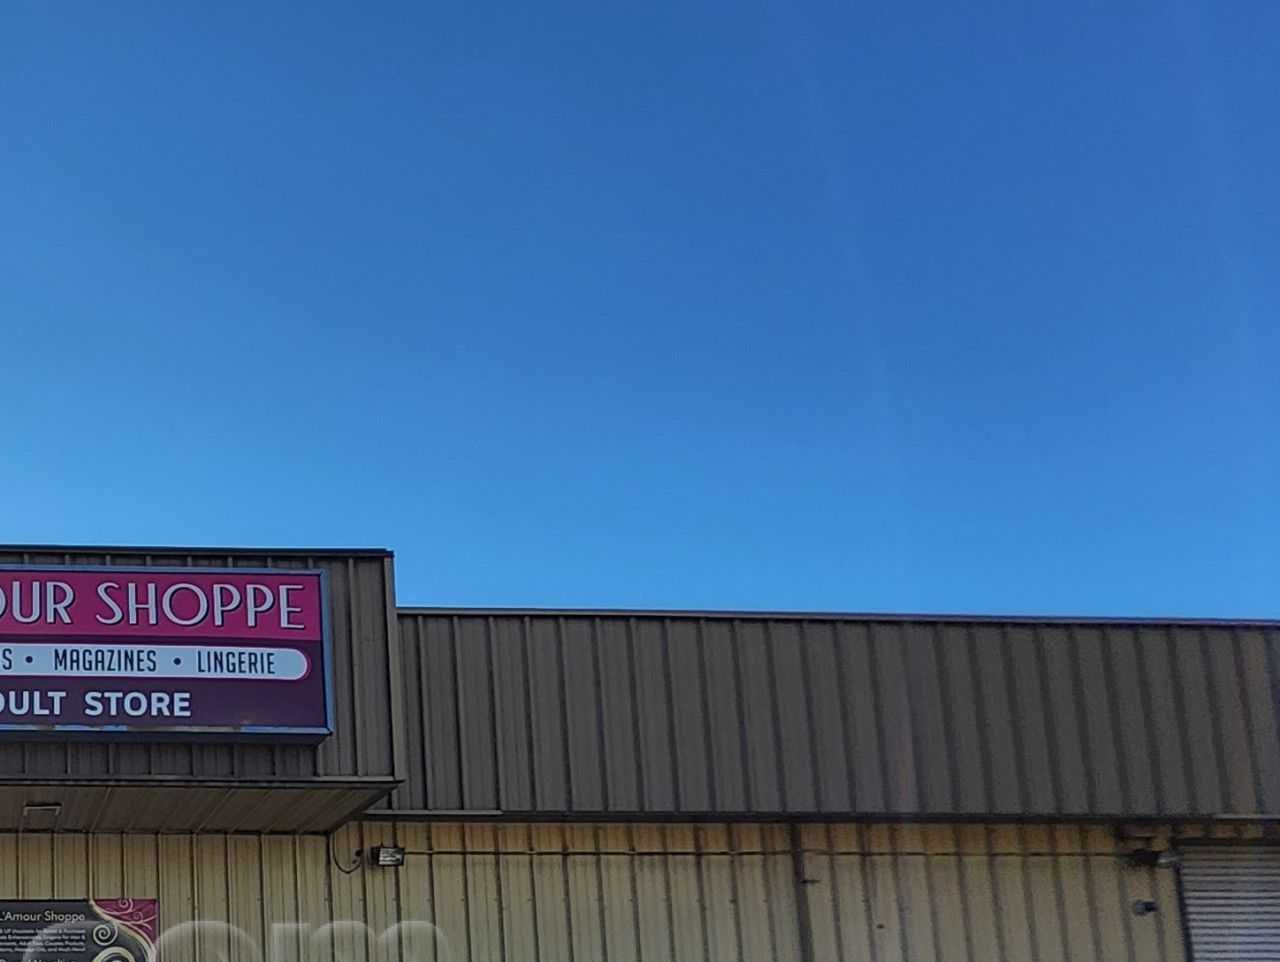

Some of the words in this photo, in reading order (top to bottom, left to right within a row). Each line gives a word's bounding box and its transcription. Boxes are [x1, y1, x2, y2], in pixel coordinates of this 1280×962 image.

[95, 582, 306, 629] SHOPPE
[54, 648, 157, 672] MAGAZINES
[197, 650, 275, 674] LINGERIE
[84, 691, 192, 717] STORE
[44, 910, 86, 924] Shoppe
